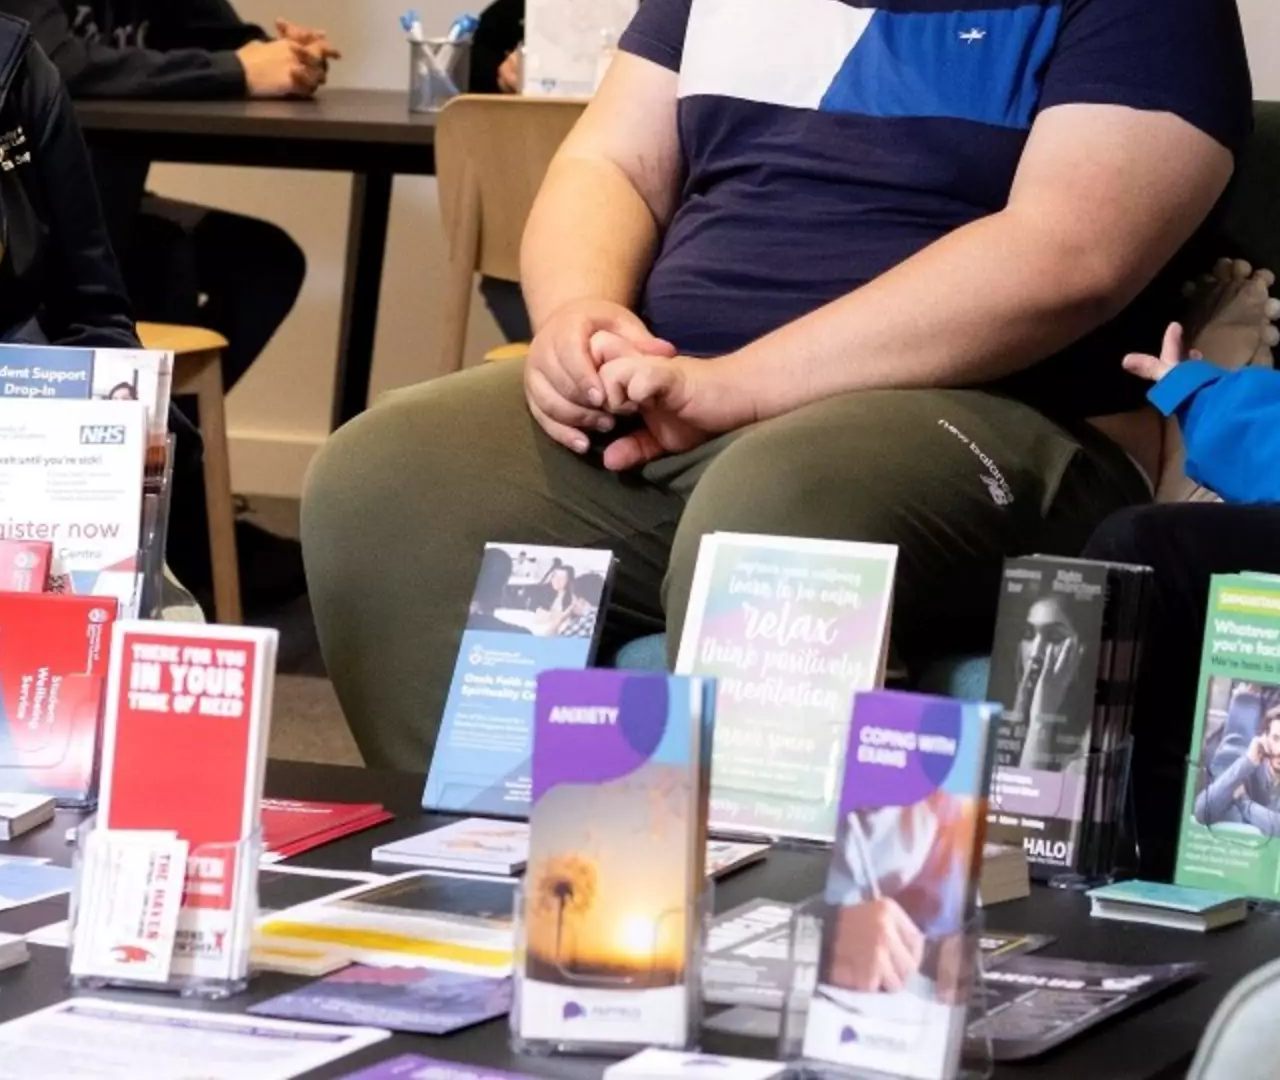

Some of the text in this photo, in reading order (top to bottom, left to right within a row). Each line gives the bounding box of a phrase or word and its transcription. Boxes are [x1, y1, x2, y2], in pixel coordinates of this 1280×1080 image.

[31, 366, 86, 383] Support
[3, 383, 56, 398] Drop-in
[81, 425, 124, 444] NHS
[16, 454, 42, 465] until
[43, 455, 77, 467] you're
[67, 522, 120, 539] now
[741, 599, 840, 647] relax
[1213, 617, 1280, 640] Whatever
[1212, 638, 1255, 655] you're
[700, 636, 862, 689] think positively
[130, 662, 245, 698] IN YOUR
[16, 674, 33, 720] Service
[28, 666, 49, 731] Wellbeing
[45, 674, 63, 724] Student
[547, 705, 620, 725] ANXIETY
[859, 725, 957, 756] COPING WITH
[857, 744, 907, 769] EXAMS
[1023, 837, 1067, 859] HALO
[144, 888, 166, 940] HAVEN
